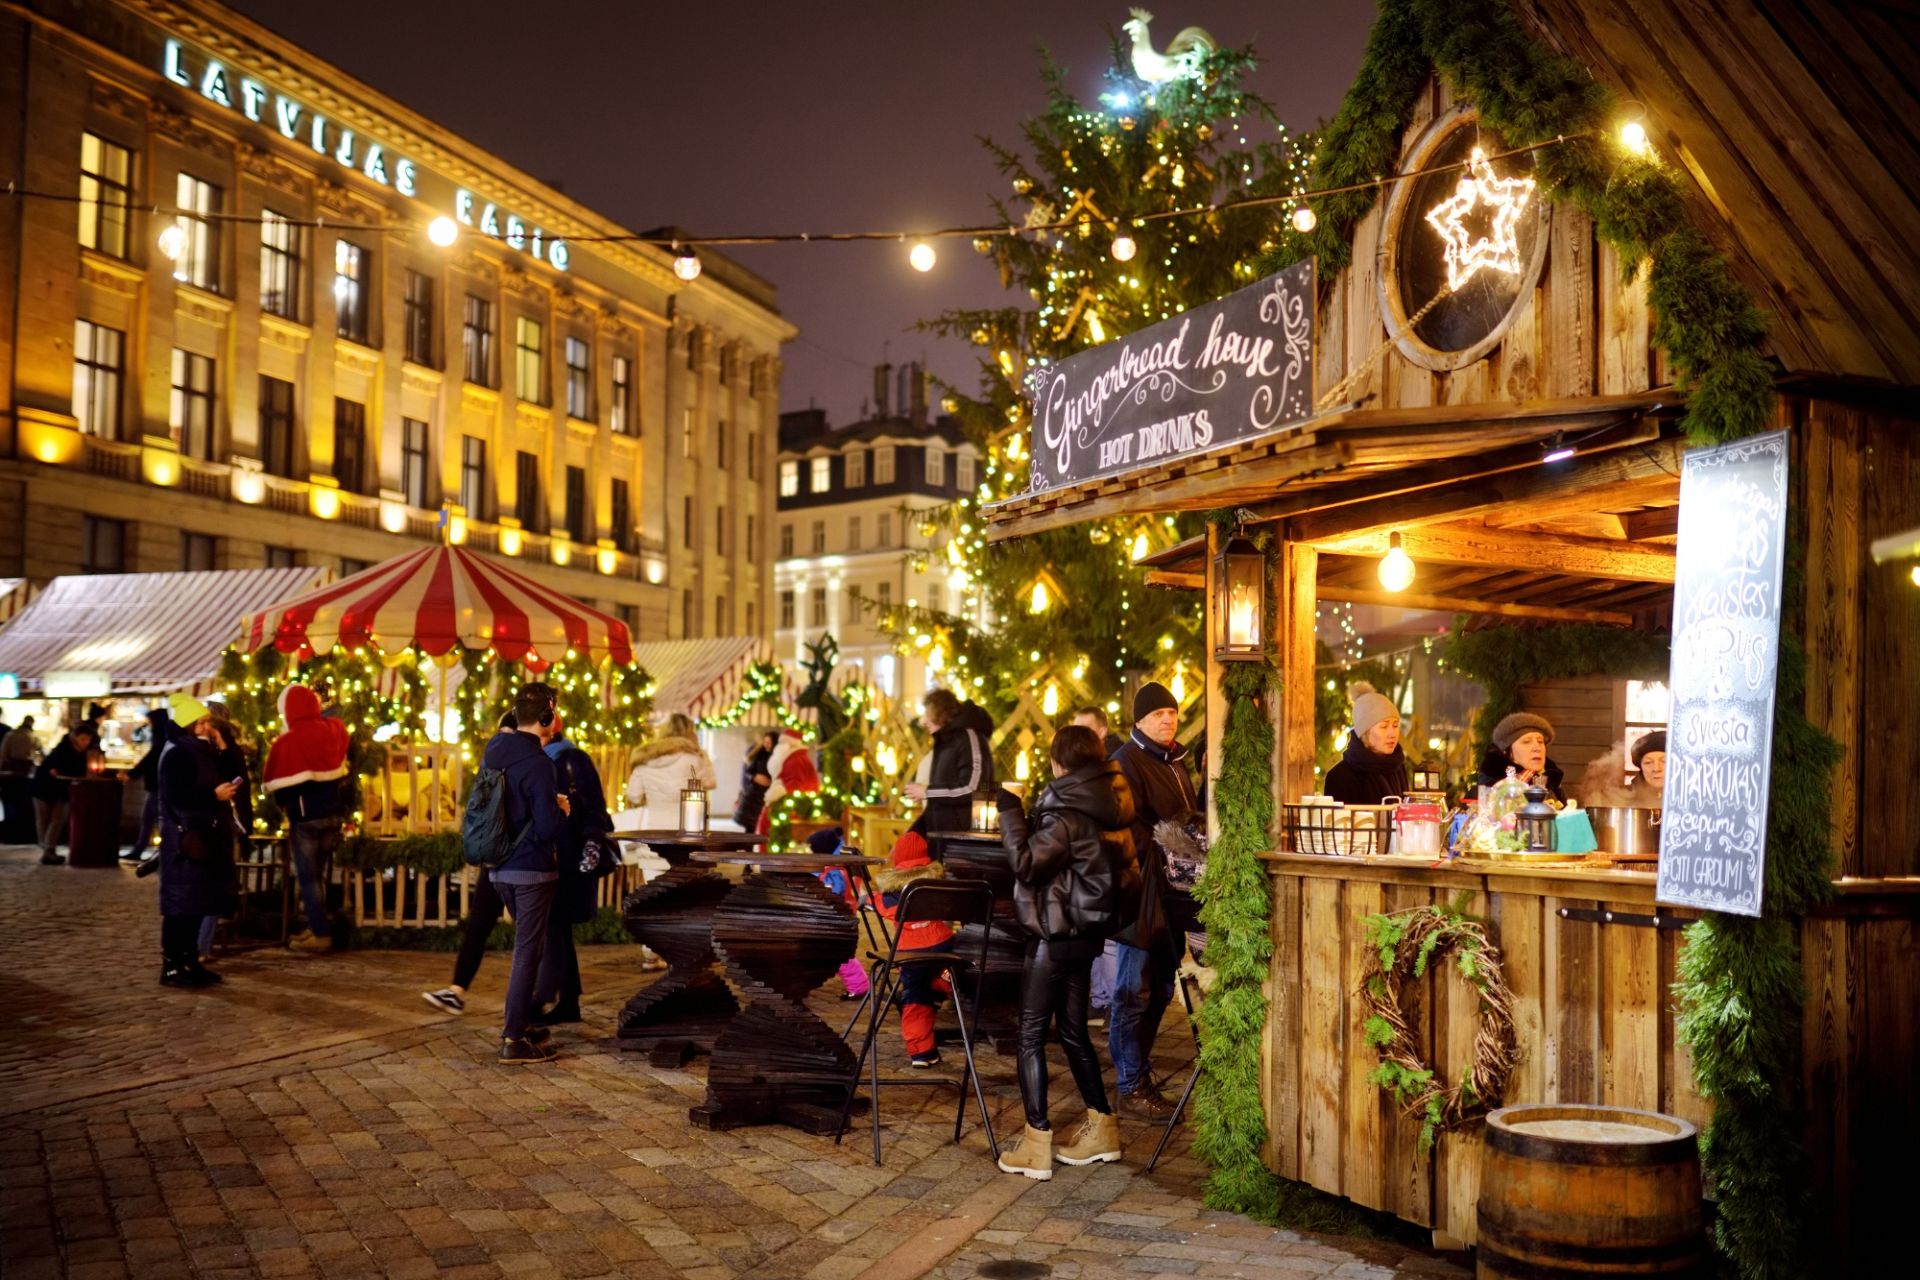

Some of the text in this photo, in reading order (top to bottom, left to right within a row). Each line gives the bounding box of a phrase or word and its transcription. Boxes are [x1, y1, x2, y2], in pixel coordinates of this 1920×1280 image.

[163, 37, 570, 273] LATVIJAS RADIO
[1044, 312, 1281, 474] Gingerbread house
[1099, 409, 1214, 469] HOT DRINKS
[1670, 855, 1744, 891] CITI GARDUMI
[1704, 836, 1713, 852] &
